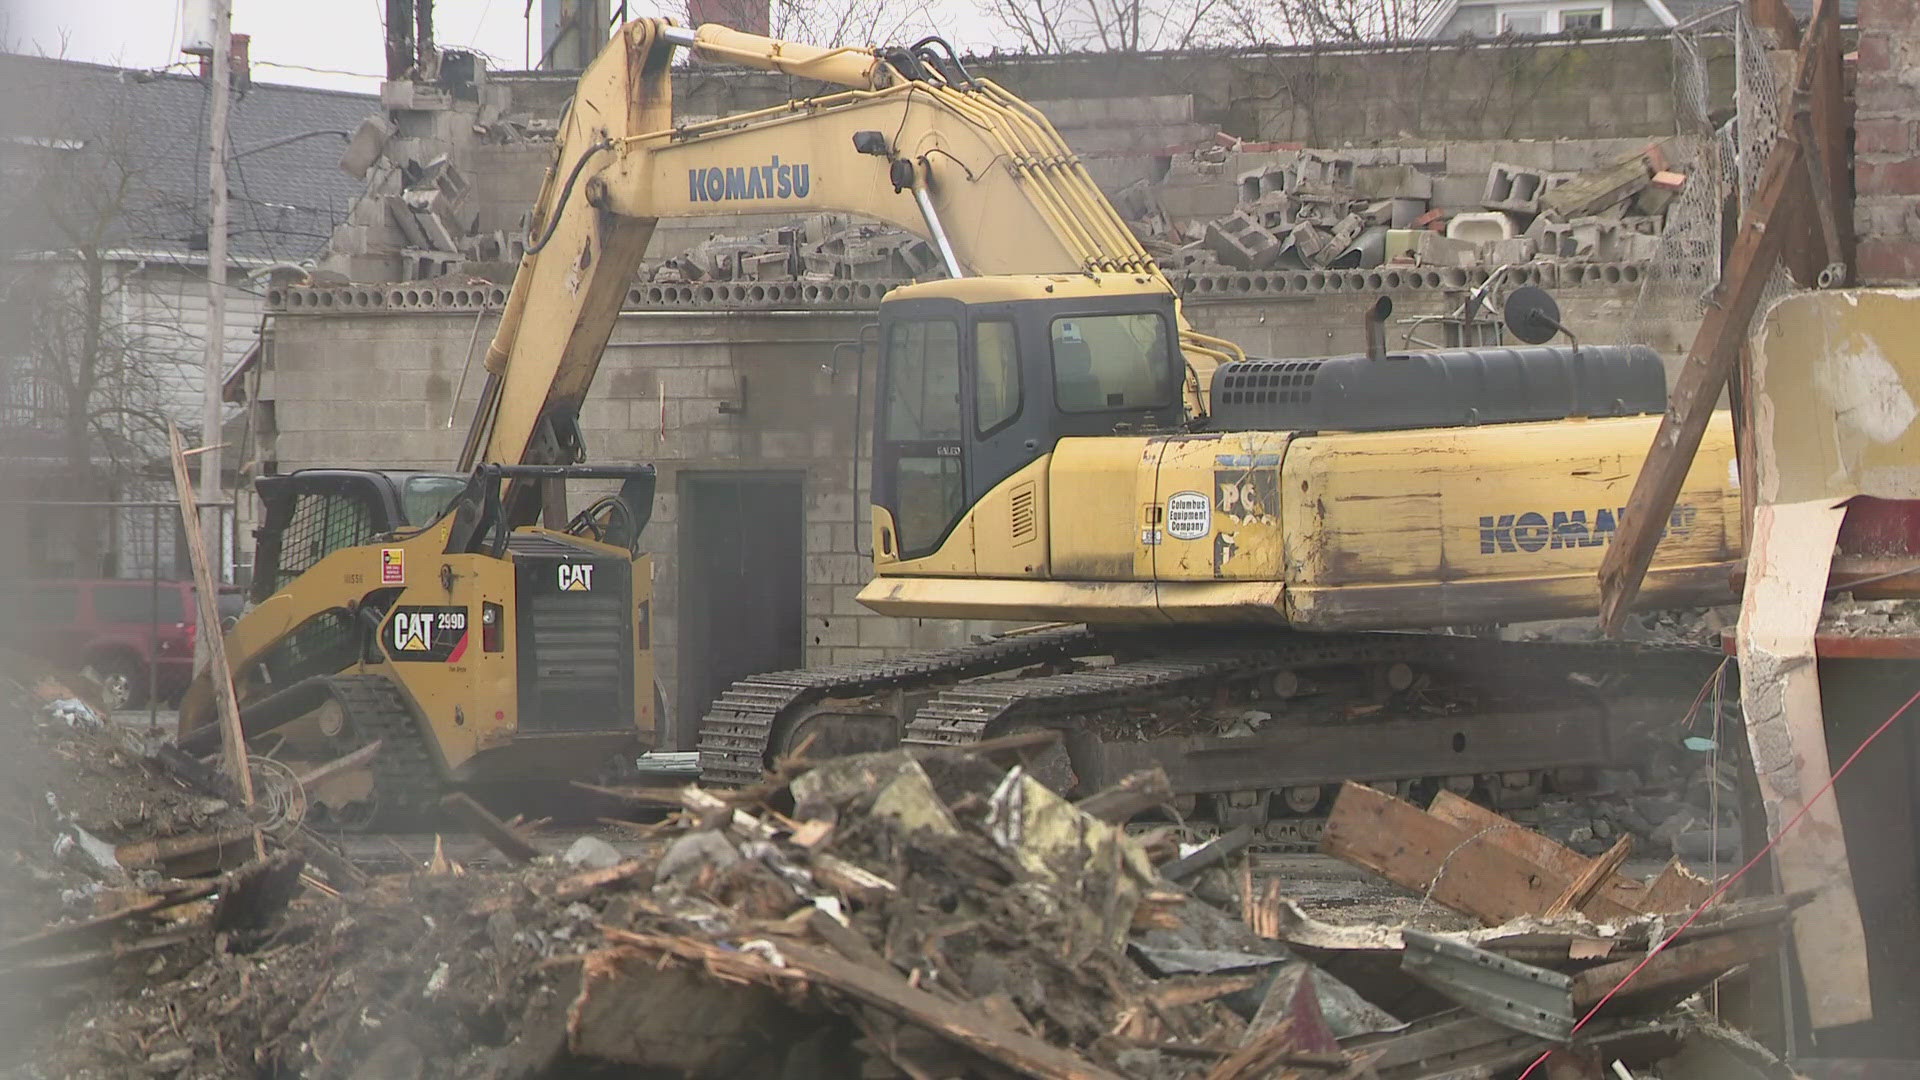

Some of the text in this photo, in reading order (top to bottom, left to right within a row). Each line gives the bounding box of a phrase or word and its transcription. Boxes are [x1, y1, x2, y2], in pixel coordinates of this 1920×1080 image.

[689, 155, 810, 202] KOMATSU
[1171, 500, 1206, 510] Columbus
[1221, 483, 1256, 512] PC
[1170, 510, 1207, 521] Equipment
[1171, 521, 1204, 531] Company
[558, 563, 594, 591] CAT
[394, 612, 466, 651] CAT 299D
